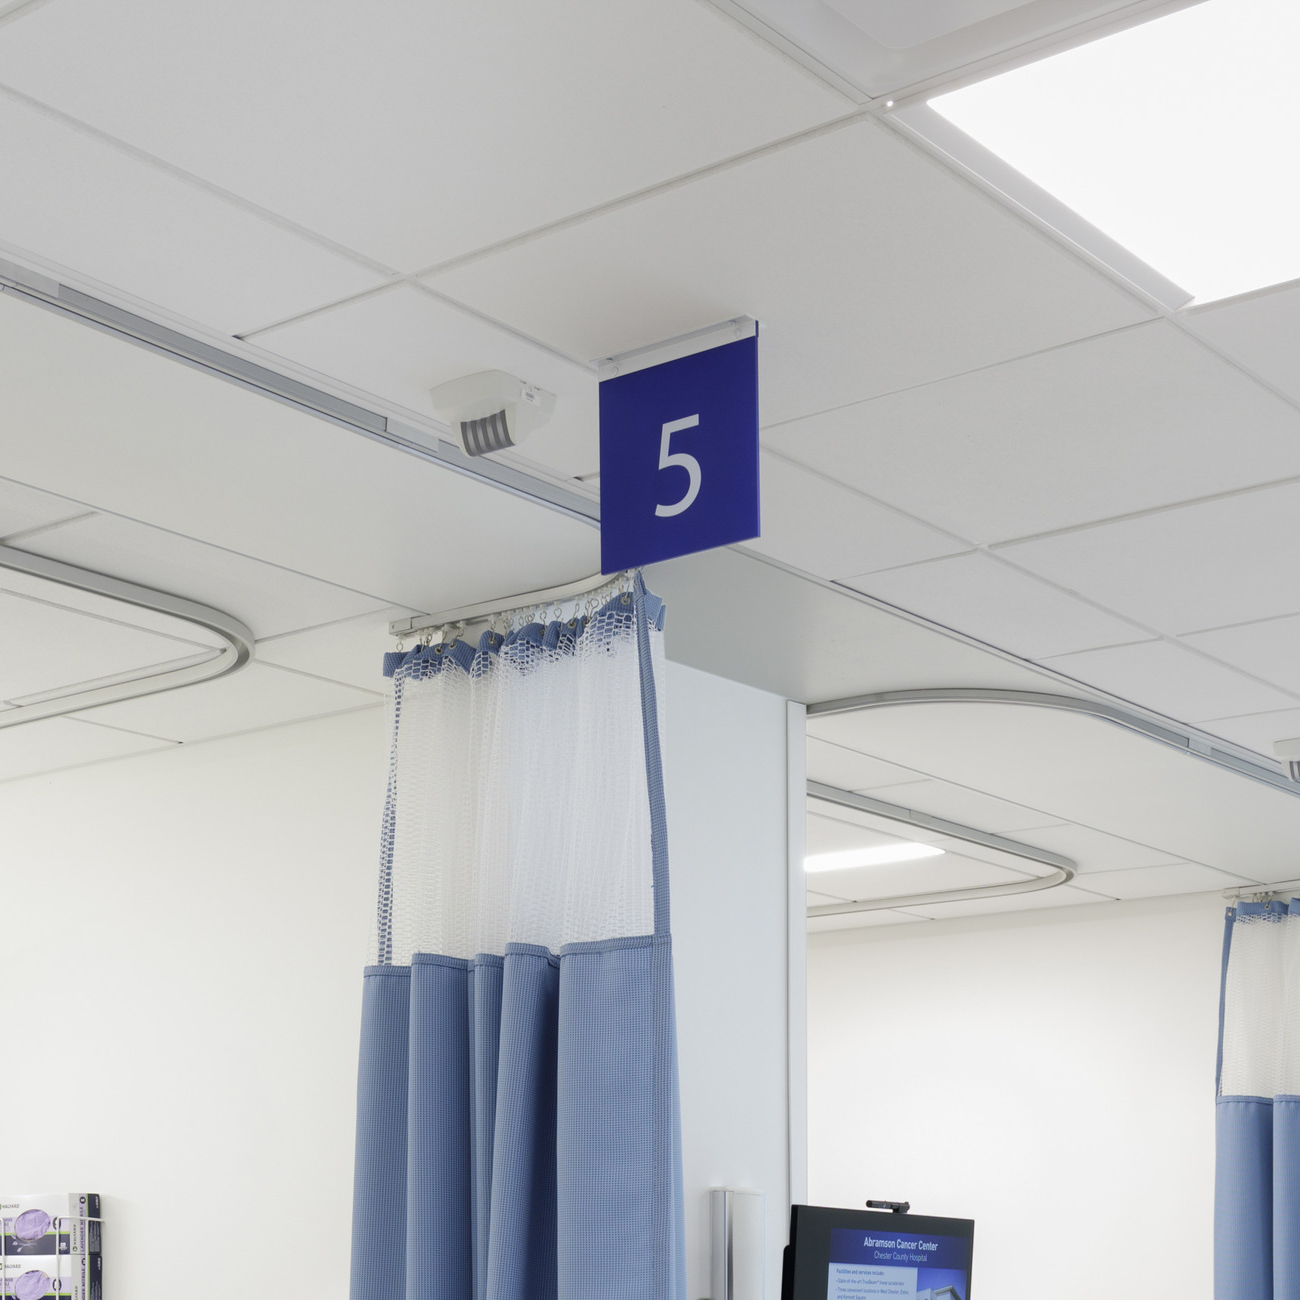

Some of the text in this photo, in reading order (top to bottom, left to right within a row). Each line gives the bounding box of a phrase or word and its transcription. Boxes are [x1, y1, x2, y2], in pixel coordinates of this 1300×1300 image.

[655, 413, 702, 517] 5
[863, 1236, 938, 1251] Abramson Cancer Center
[874, 1250, 928, 1263] Chester County Hospital
